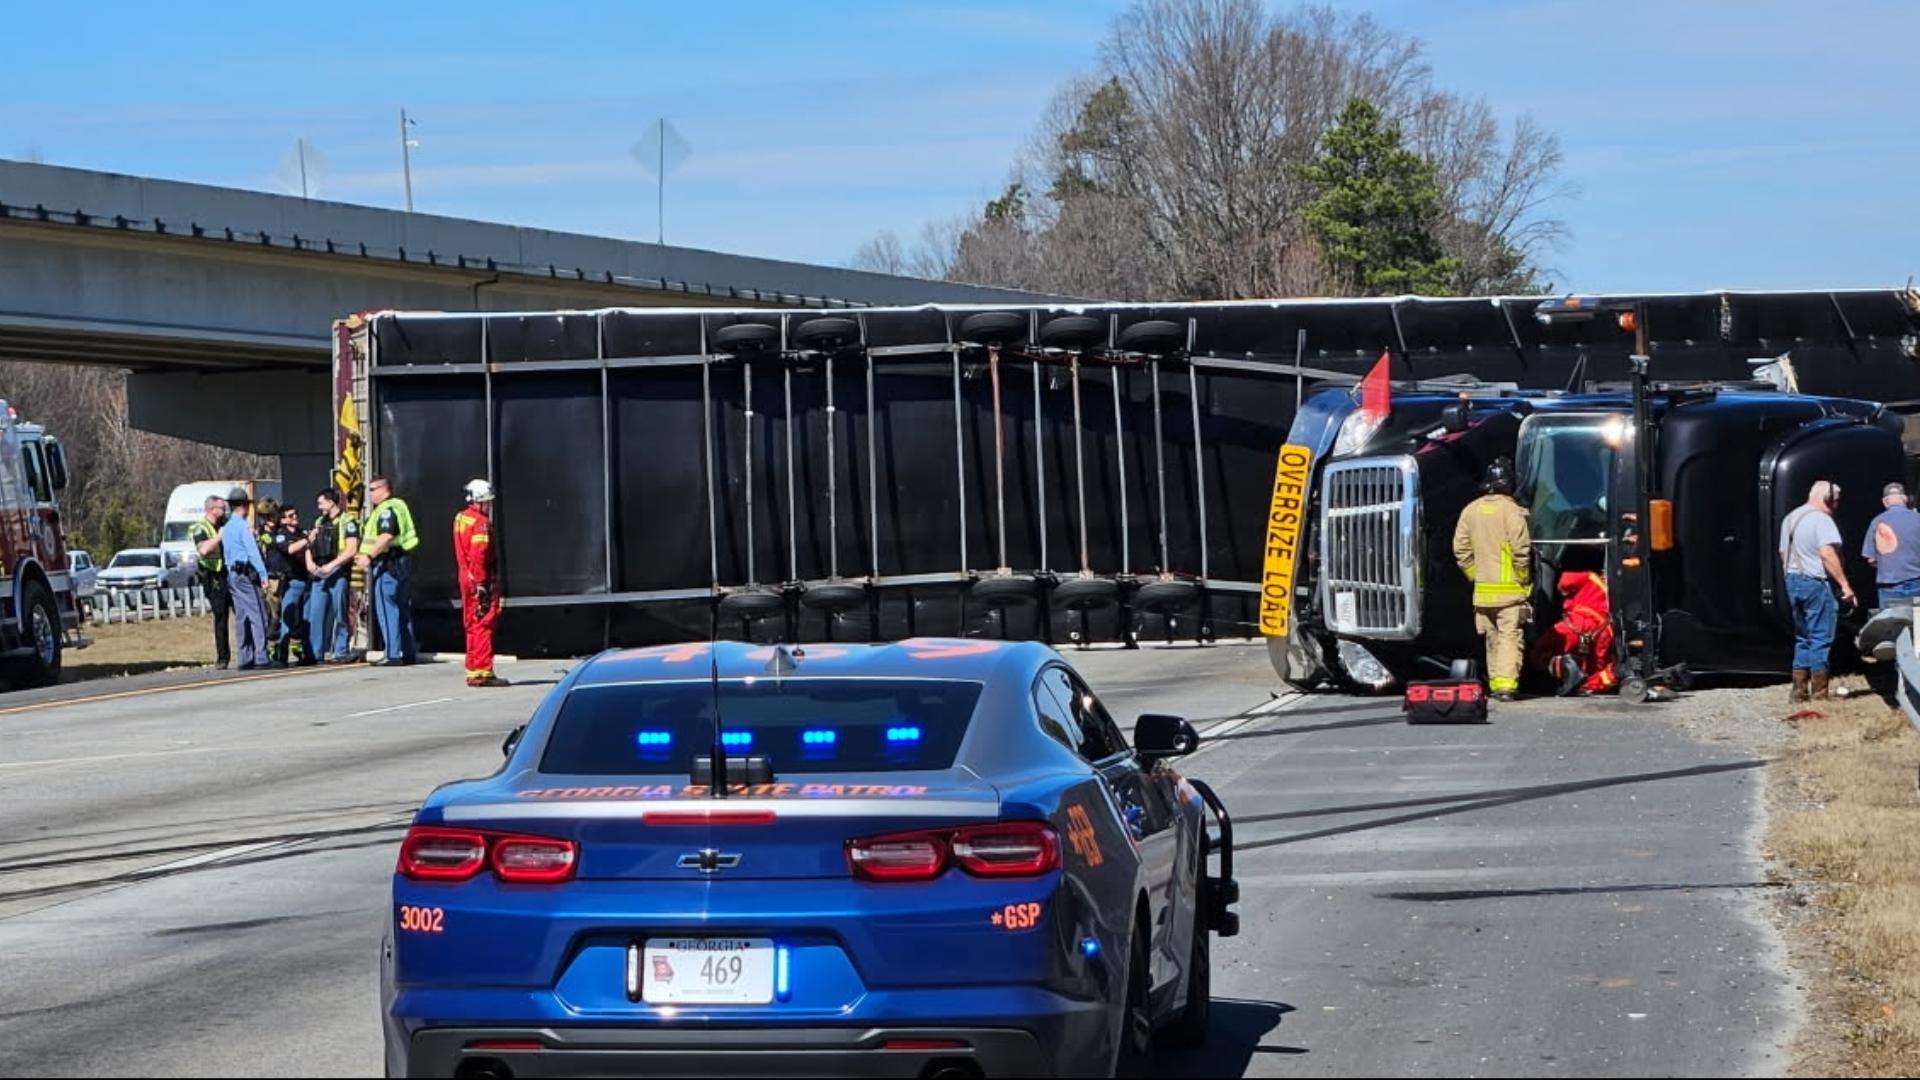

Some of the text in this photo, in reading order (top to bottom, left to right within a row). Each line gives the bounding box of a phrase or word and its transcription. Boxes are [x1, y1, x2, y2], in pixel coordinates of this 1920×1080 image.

[1261, 452, 1307, 630] OVERSIZE LOAD
[516, 783, 929, 798] GEORGIA SATE PATROL
[400, 905, 444, 931] 3002
[676, 940, 744, 951] GEORGIA
[701, 955, 742, 985] 469
